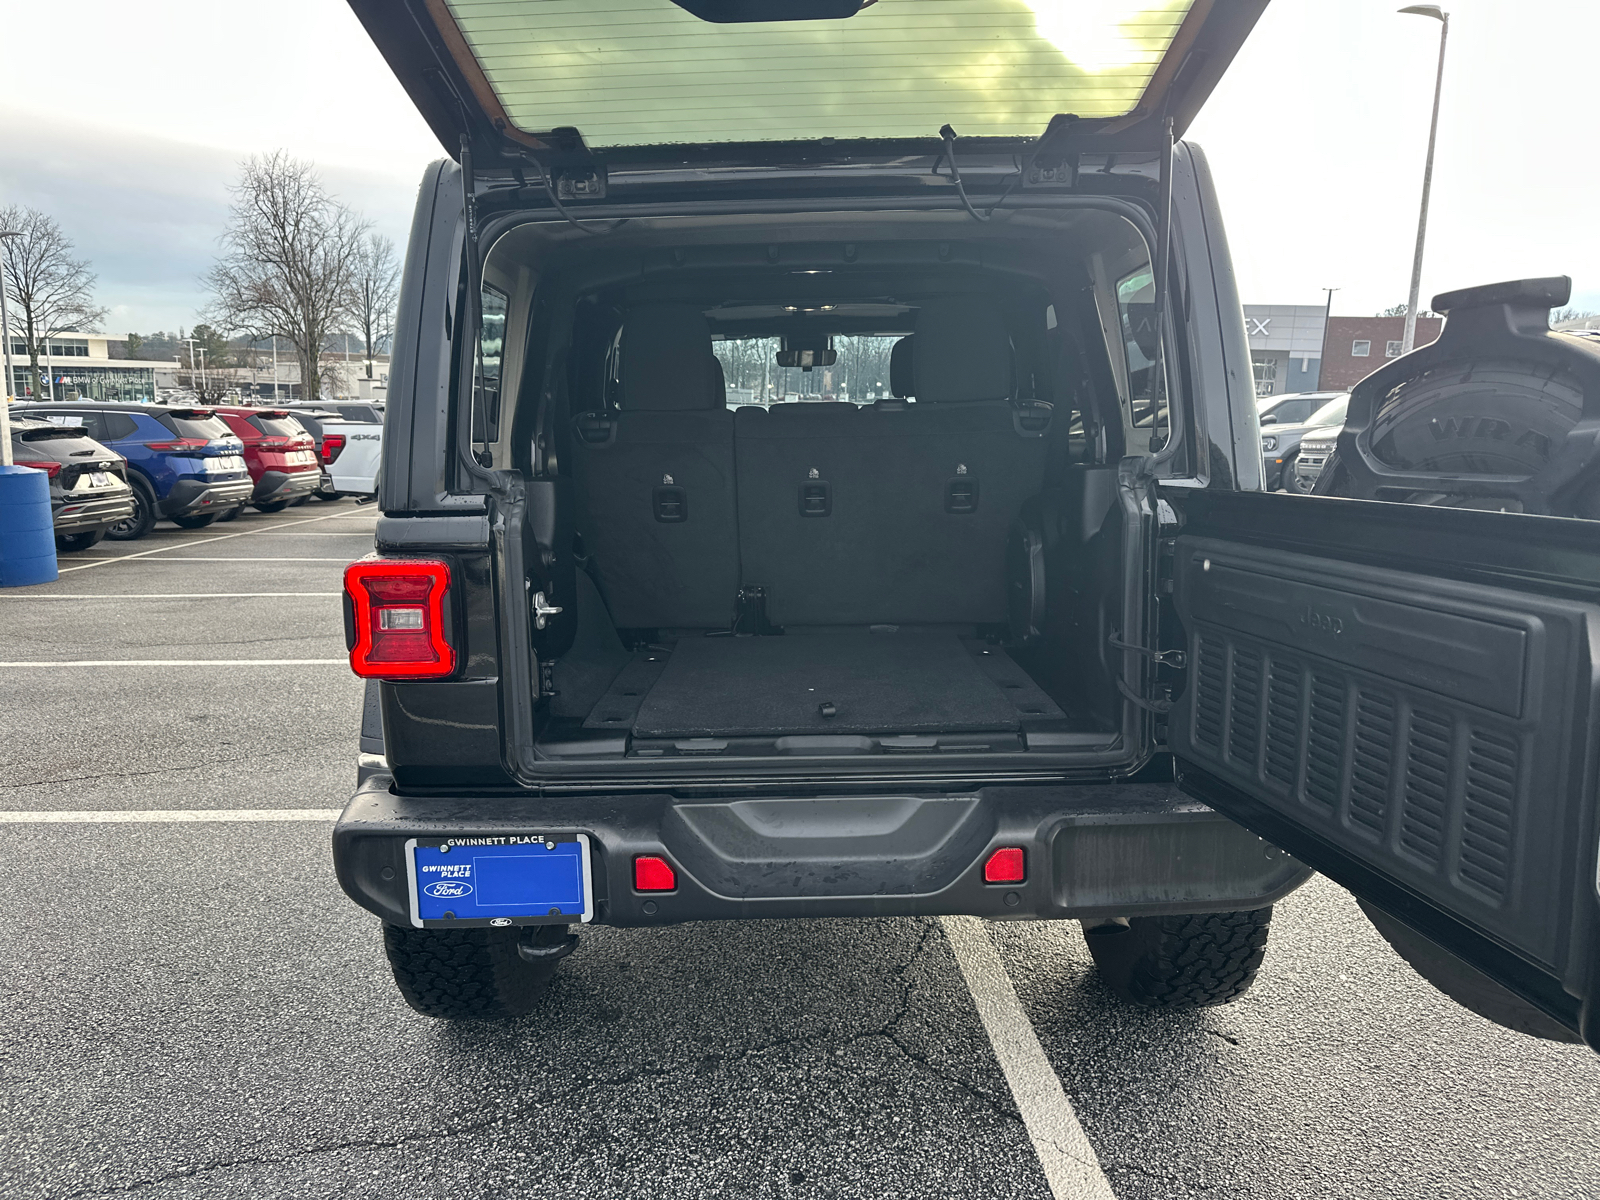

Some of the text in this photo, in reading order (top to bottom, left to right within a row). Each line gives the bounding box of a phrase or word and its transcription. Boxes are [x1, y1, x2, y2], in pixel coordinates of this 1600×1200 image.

[73, 376, 90, 384] BMW
[91, 376, 99, 384] of
[128, 376, 145, 384] Place
[1300, 604, 1343, 640] Jeep
[447, 835, 545, 847] GWINNETT PLACE
[422, 864, 471, 873] GWINNETT
[441, 870, 471, 878] PLACE
[433, 883, 463, 896] Ford
